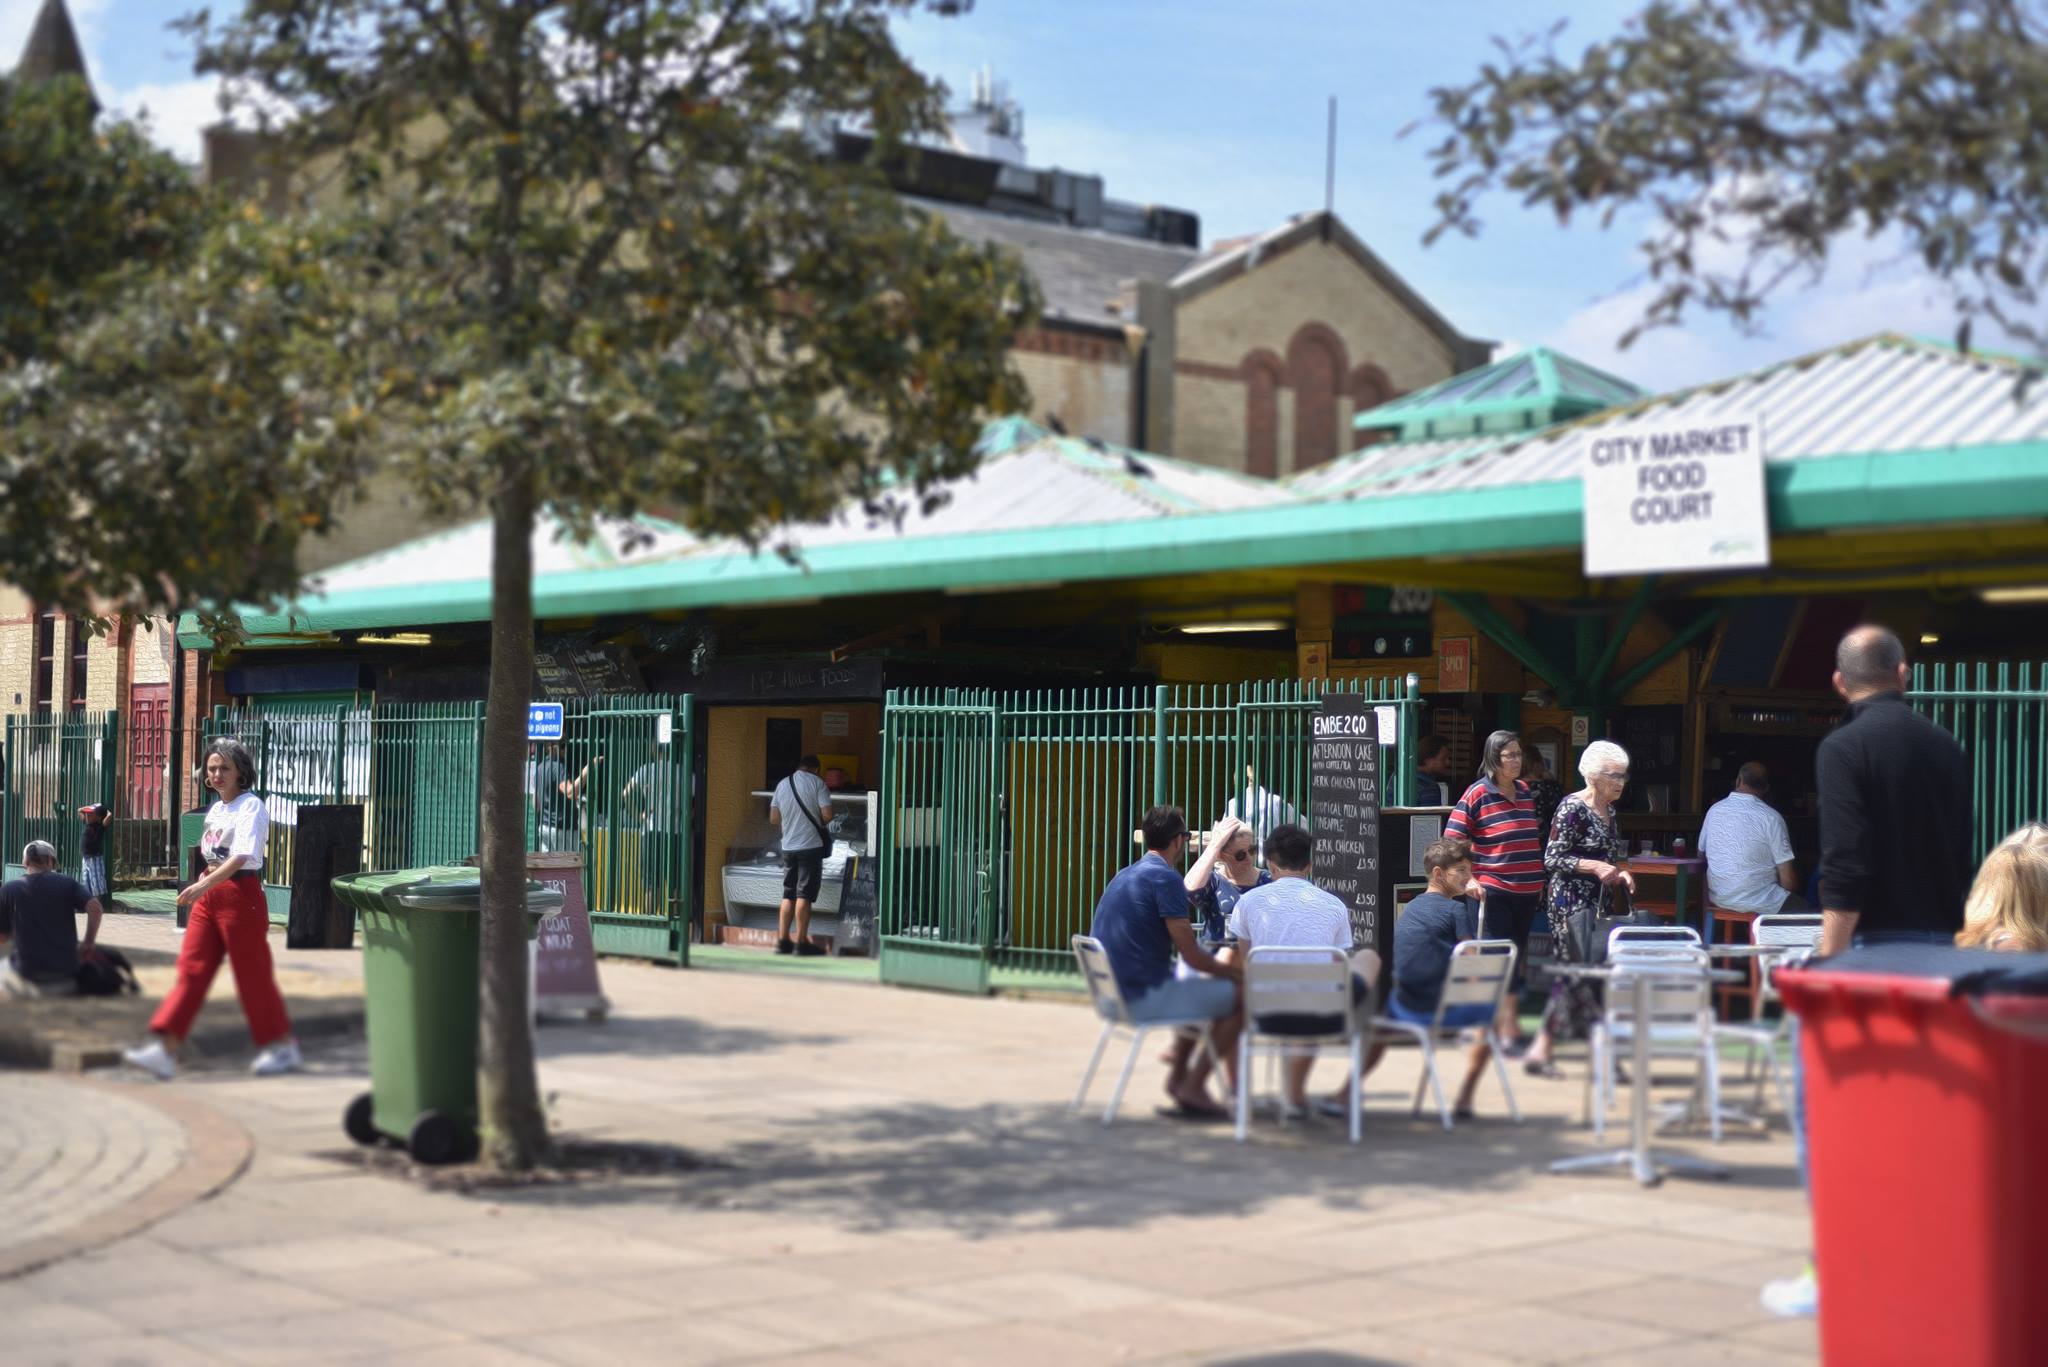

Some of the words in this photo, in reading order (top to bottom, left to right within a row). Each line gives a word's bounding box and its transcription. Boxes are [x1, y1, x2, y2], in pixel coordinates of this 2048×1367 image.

[1591, 436, 1644, 466] CITY
[1650, 425, 1750, 459] MARKET
[1637, 461, 1707, 492] FOOD
[1631, 492, 1713, 525] COURT
[1314, 715, 1367, 735] EMBE2GO
[1313, 743, 1352, 759] AFTERNOON
[1354, 744, 1372, 760] CAKE
[1313, 775, 1329, 787] JERK
[1331, 776, 1356, 790] CHICKEN
[1358, 778, 1376, 791] PIZZA
[1343, 804, 1358, 818] PIZZA
[1316, 839, 1333, 853] JERK
[1335, 840, 1365, 855] CHICKEN
[1315, 854, 1336, 868] WRAP
[1313, 876, 1337, 892] VEGAN
[1337, 879, 1358, 893] WRAP
